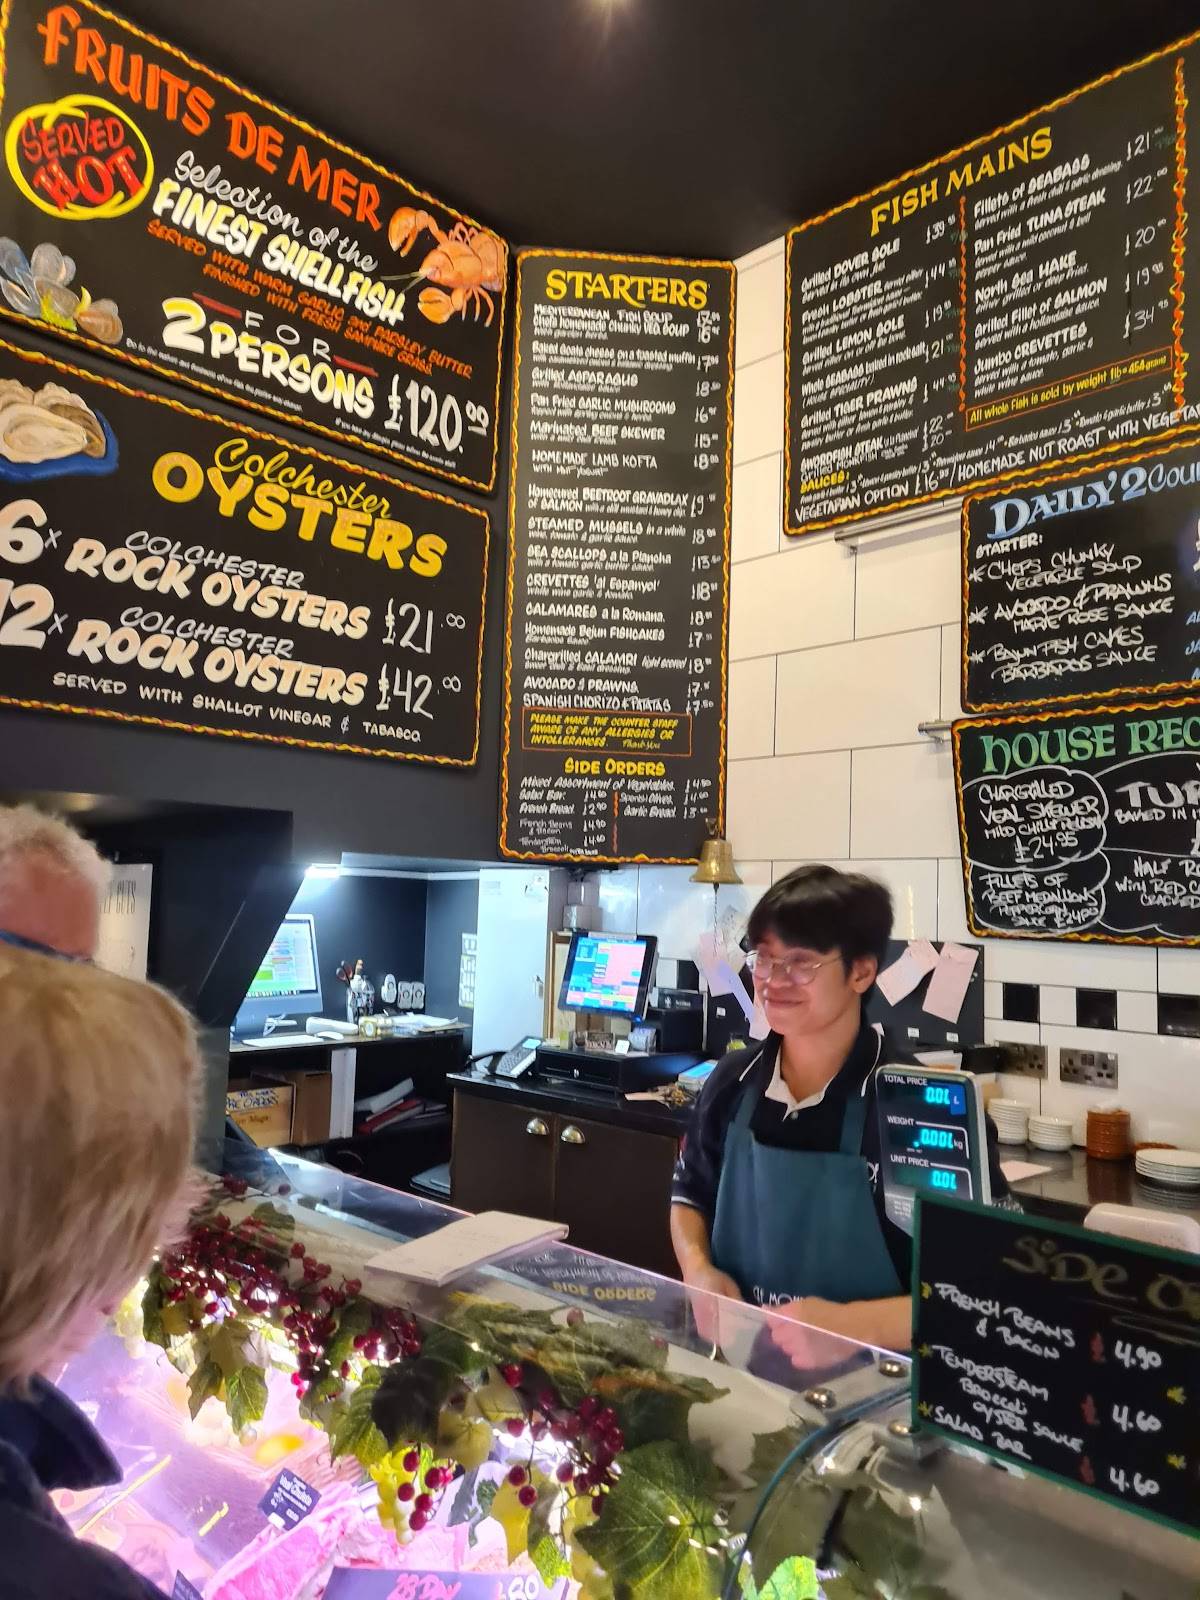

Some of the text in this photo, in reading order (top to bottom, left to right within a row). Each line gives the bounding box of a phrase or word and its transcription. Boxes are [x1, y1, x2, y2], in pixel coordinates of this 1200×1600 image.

[20, 111, 126, 165] SERVED
[32, 143, 145, 213] HOT
[225, 110, 284, 175] DE
[288, 144, 383, 232] MER
[870, 126, 1053, 237] FISH MAINS
[1027, 153, 1090, 195] SEABASS
[174, 149, 379, 273] Selection of the
[1026, 205, 1064, 233] TUNA
[1064, 186, 1106, 219] STEAK
[152, 177, 406, 326] FINEST SHELLFISH
[834, 237, 900, 279] DOVER SOLE
[1038, 250, 1077, 281] HAKE
[147, 218, 207, 256] SERVED
[212, 250, 249, 276] WITH
[254, 269, 294, 296] WARM
[298, 291, 345, 321] GARLIC
[428, 349, 473, 380] BUTTER
[203, 263, 260, 297] FINISHED
[267, 292, 298, 314] WITH
[302, 306, 342, 334] FRESH
[546, 269, 708, 310] STARTERS
[1054, 277, 1108, 310] SALMON
[836, 314, 905, 352] LEMON SOLE
[1014, 321, 1088, 360] CREVETTES
[162, 297, 206, 354] 2
[209, 321, 375, 420] PERSONS
[834, 375, 918, 418] TIGER PRAWNS
[969, 409, 983, 425] All
[984, 402, 1009, 420] whole
[1040, 386, 1060, 403] sold
[1062, 381, 1075, 400] by
[1076, 372, 1107, 394] weight
[591, 423, 619, 438] BEEF
[214, 438, 391, 519] Colchester
[592, 452, 658, 470] LAMB KOFTA
[795, 493, 861, 523] VEGETARIAN
[864, 480, 909, 505] OPTION
[958, 450, 1026, 481] HOMEMADE
[1029, 440, 1059, 464] NUT
[1058, 426, 1106, 456] ROAST
[1108, 419, 1139, 441] WITH
[152, 451, 447, 577] OYSTERS
[987, 470, 1118, 541] DAILY
[1120, 466, 1148, 502] 2
[528, 516, 643, 535] STEAMED MUSSELS
[125, 531, 304, 589] COLCHESTER
[526, 573, 589, 589] CREVETTES
[1006, 555, 1142, 592] VEGETABLE SOUP
[64, 537, 196, 600] ROCK
[201, 572, 370, 640] OYSTERS
[1085, 573, 1172, 602] PRAWNS
[526, 602, 597, 619] CALAMARES
[1059, 607, 1109, 625] ROSE
[1114, 596, 1175, 619] SAUCE
[119, 606, 294, 659] COLCHESTER
[1084, 625, 1144, 648] CAKES
[67, 618, 198, 680] ROCK
[203, 647, 368, 706] OYSTERS
[523, 675, 576, 691] AVOCADO
[991, 645, 1158, 683] BARBADOS SAUCE
[52, 671, 127, 695] SERVED
[139, 685, 183, 704] WITH
[193, 694, 262, 718] SHALLOT
[269, 706, 331, 729] VINEGAR
[564, 756, 666, 777] SIDE ORDERS
[980, 795, 1100, 825] VEAL SKEWER
[1043, 872, 1069, 888] OF
[884, 1074, 928, 1087] TOTAL PRICE
[887, 1115, 915, 1127] WEIGHT
[890, 1154, 930, 1168] UNIT PRICE
[953, 1138, 964, 1150] kg
[934, 1281, 1076, 1349] FRENCH BEANS
[995, 1326, 1060, 1360] BACON
[1113, 1340, 1163, 1371] 4.90
[972, 1401, 1163, 1454] OYSTER SAUCE 4.60
[934, 1405, 1160, 1497] SALAD BAR 4.60
